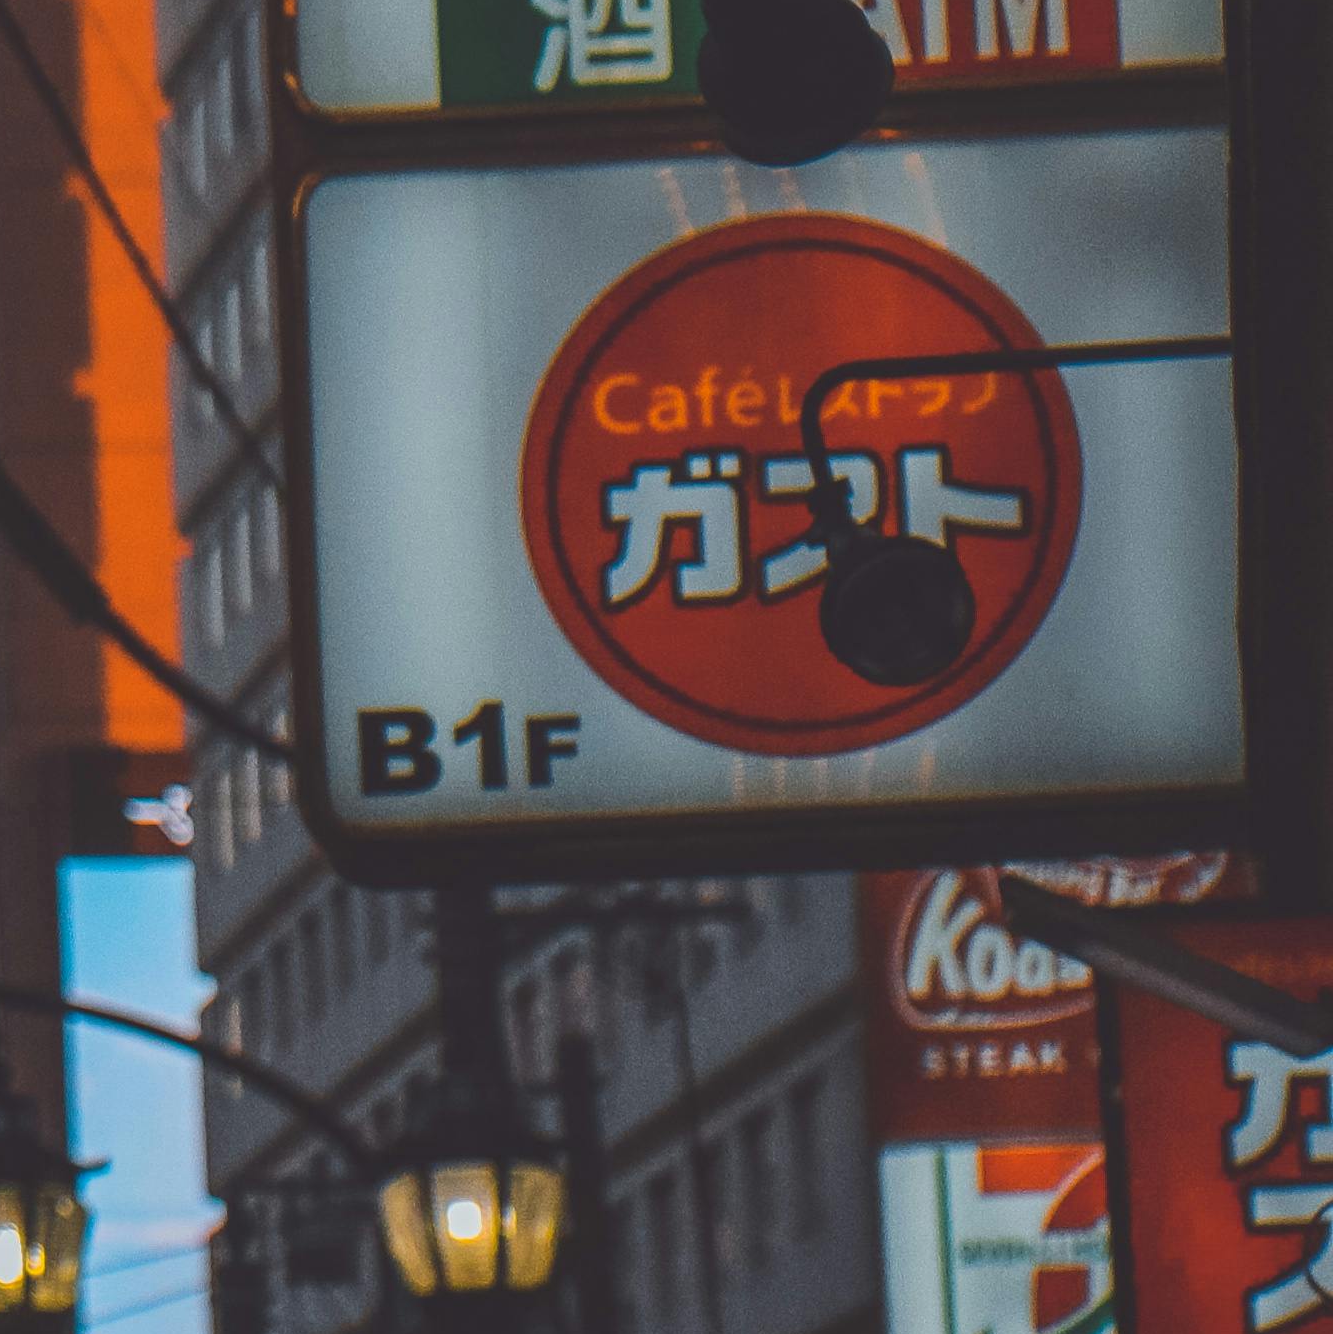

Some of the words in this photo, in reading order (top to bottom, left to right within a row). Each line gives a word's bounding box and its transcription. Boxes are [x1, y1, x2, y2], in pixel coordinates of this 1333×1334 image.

[609, 447, 1025, 603] ガスト
[357, 701, 582, 797] B1F
